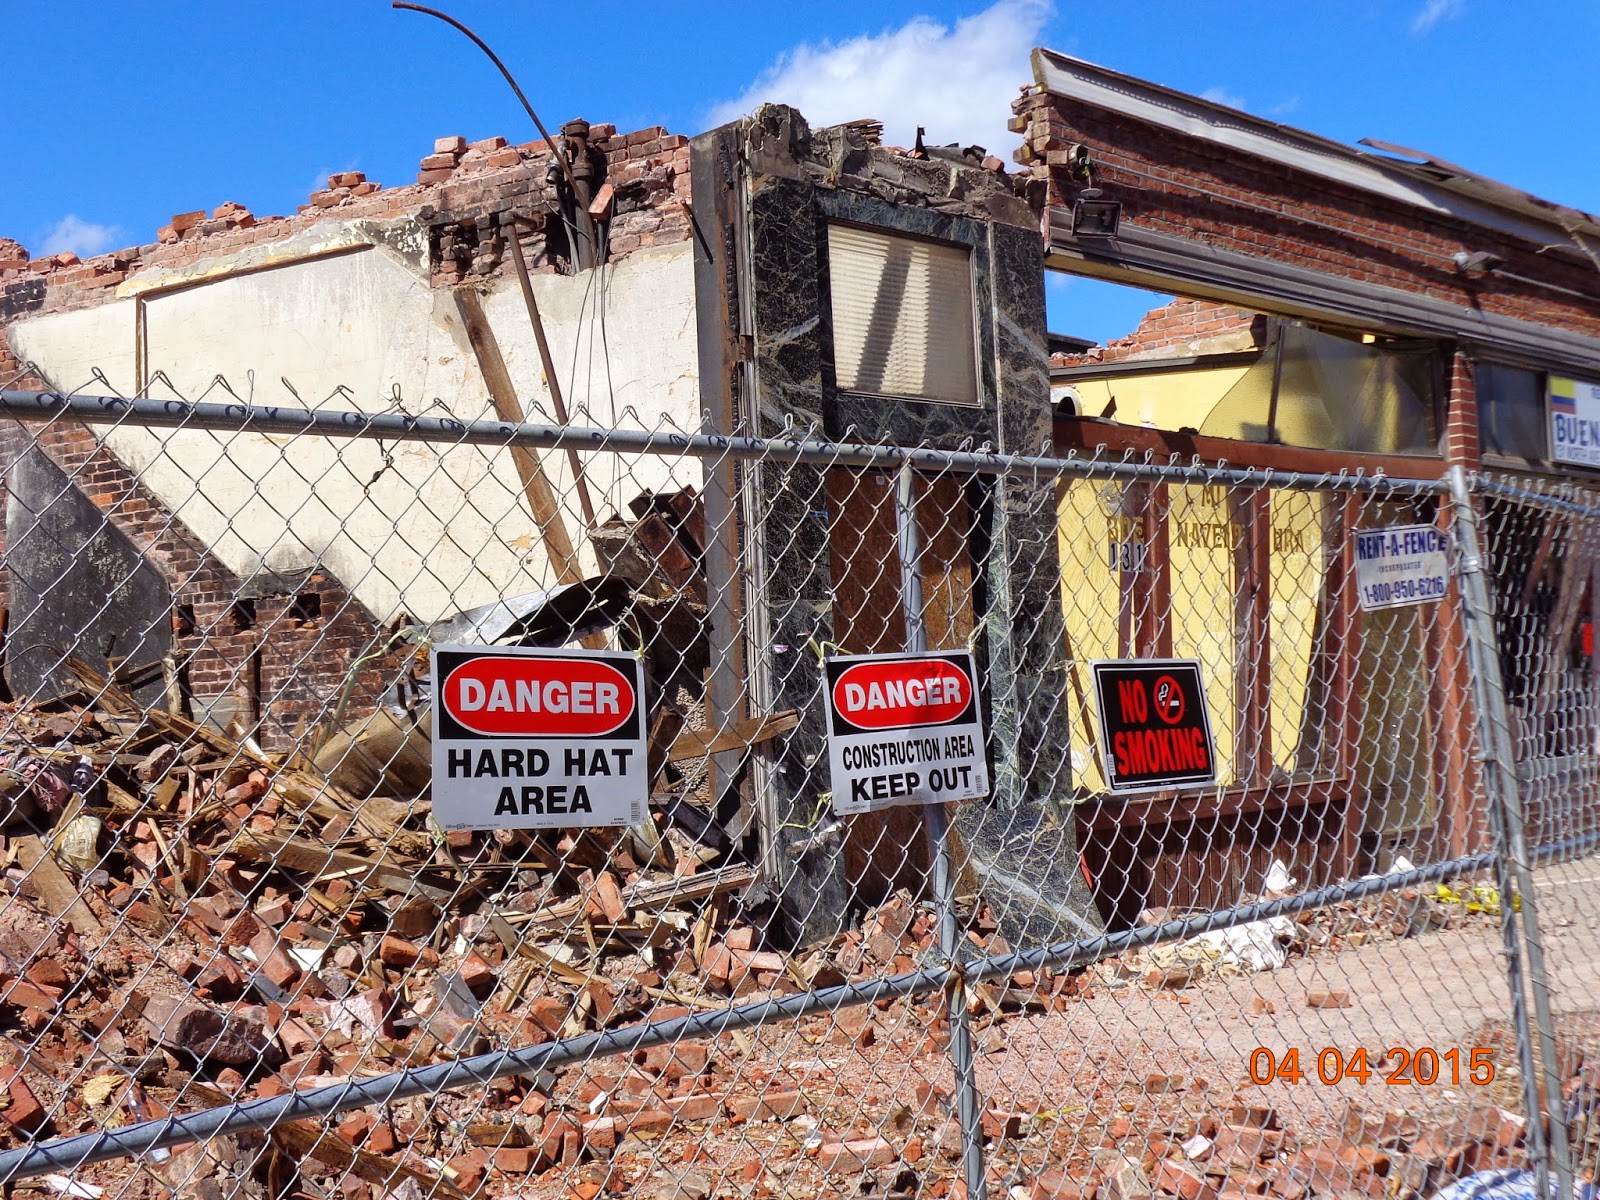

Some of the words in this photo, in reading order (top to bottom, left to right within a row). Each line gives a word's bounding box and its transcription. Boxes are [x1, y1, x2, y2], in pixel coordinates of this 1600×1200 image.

[1111, 543, 1142, 570] 131
[1358, 530, 1447, 560] RENT-A-FENCE
[1364, 576, 1444, 603] 1-800-950-6216
[459, 678, 620, 714] DANGER
[844, 676, 962, 712] DANGER
[1118, 679, 1148, 723] NO
[447, 748, 550, 778] HARD
[564, 748, 634, 777] HAT
[842, 737, 940, 771] CONSTRUCTION
[944, 734, 975, 760] AREA
[1114, 727, 1207, 776] SMOKING
[494, 785, 592, 816] AREA
[851, 772, 920, 802] KEEP
[928, 765, 972, 793] OUT
